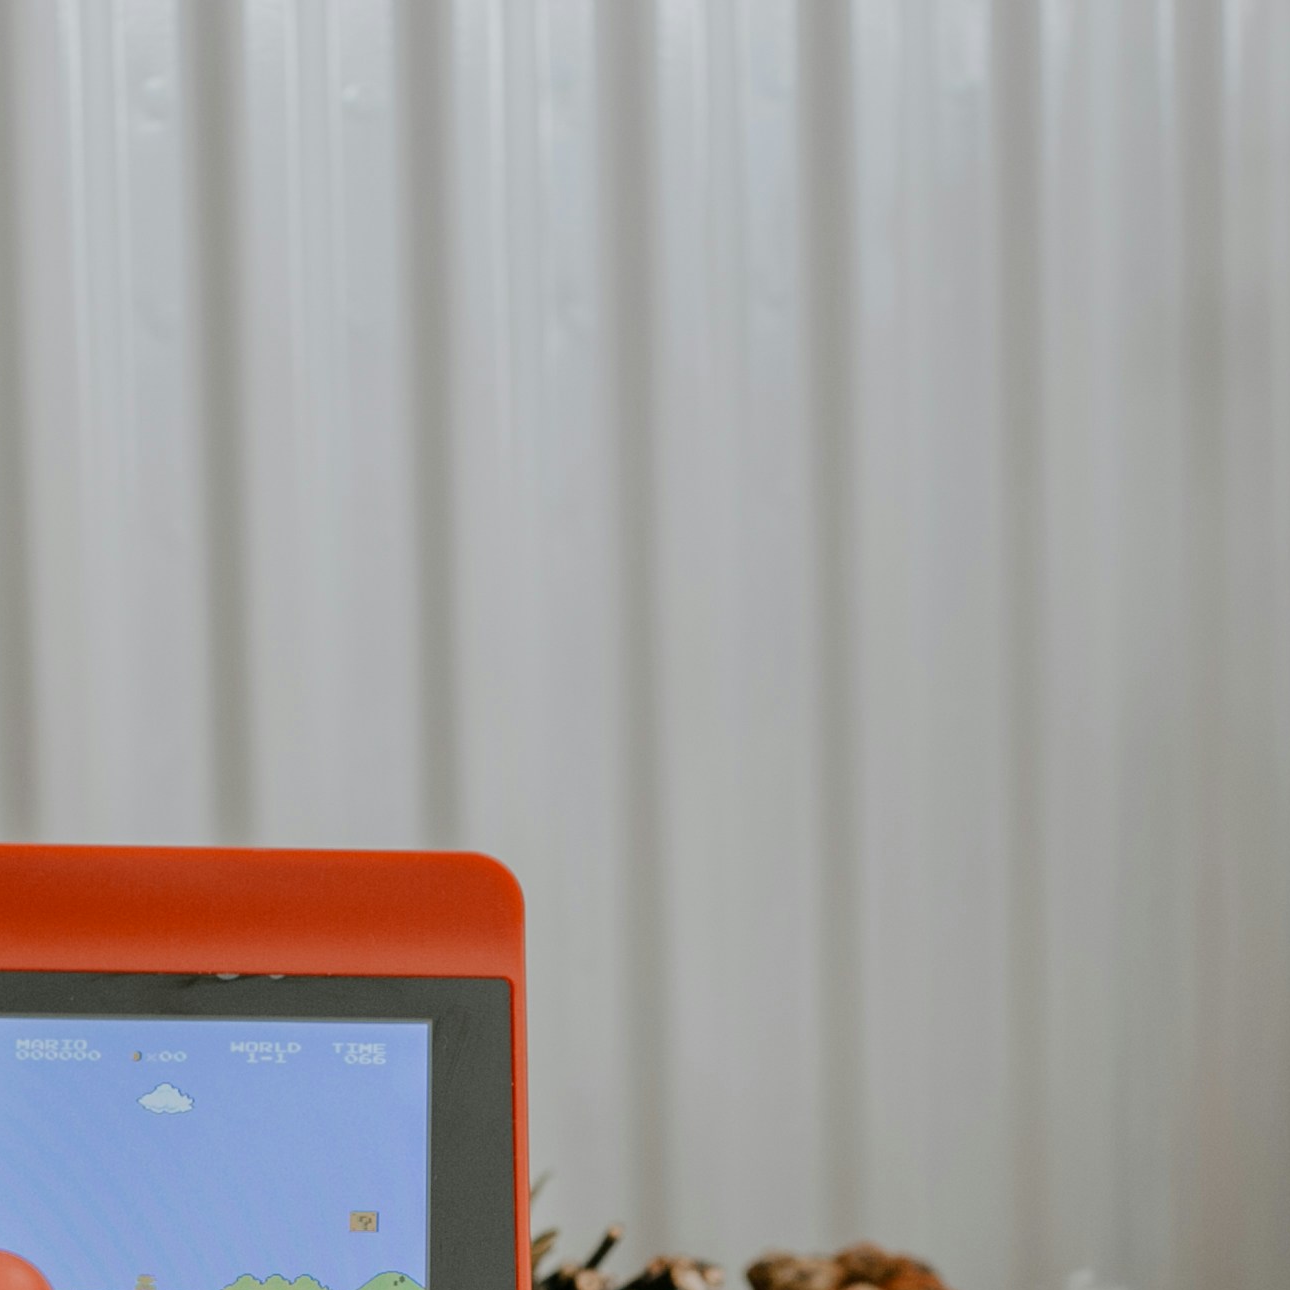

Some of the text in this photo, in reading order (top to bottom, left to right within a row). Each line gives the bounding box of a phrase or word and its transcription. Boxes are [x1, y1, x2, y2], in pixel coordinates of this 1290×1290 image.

[15, 1039, 387, 1054] MARIO WORLD TIME
[15, 1049, 102, 1061] 000000
[246, 1053, 287, 1063] 1-1
